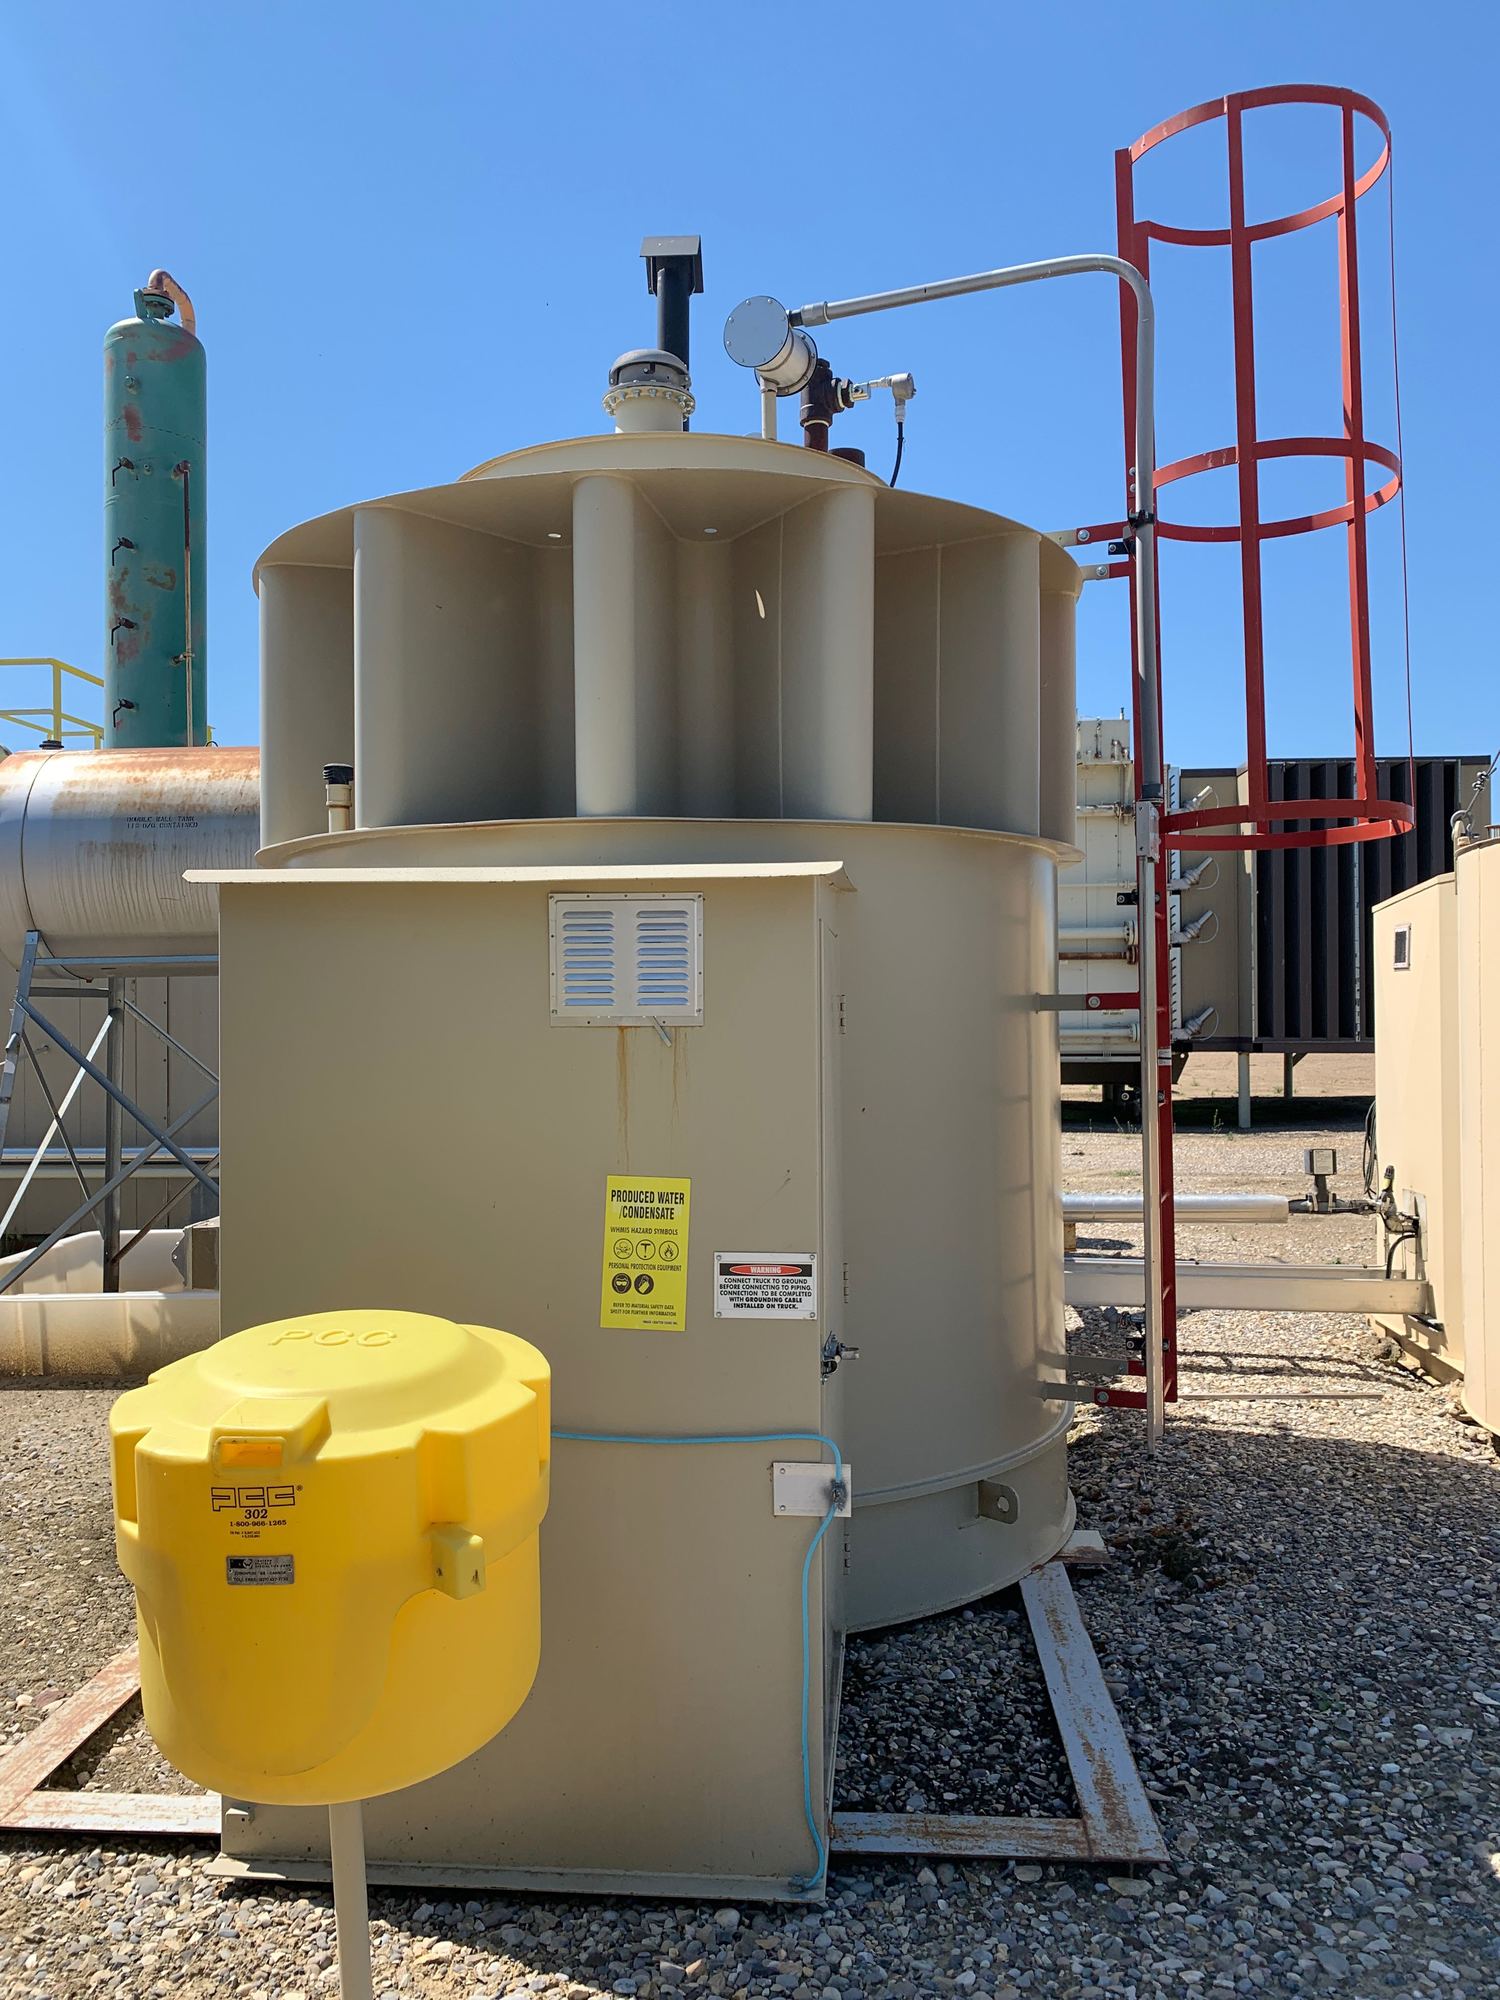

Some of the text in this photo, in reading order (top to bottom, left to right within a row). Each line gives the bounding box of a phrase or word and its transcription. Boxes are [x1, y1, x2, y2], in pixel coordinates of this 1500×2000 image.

[611, 1189, 685, 1205] PRODUCED WATER
[631, 1227, 653, 1235] HAZARD
[653, 1228, 679, 1236] SYMBOLS
[630, 1263, 656, 1271] PROTECTION
[657, 1264, 682, 1272] EQUIPMENT
[268, 1329, 397, 1347] PCC
[211, 1485, 296, 1512] PCC
[244, 1509, 268, 1519] 302
